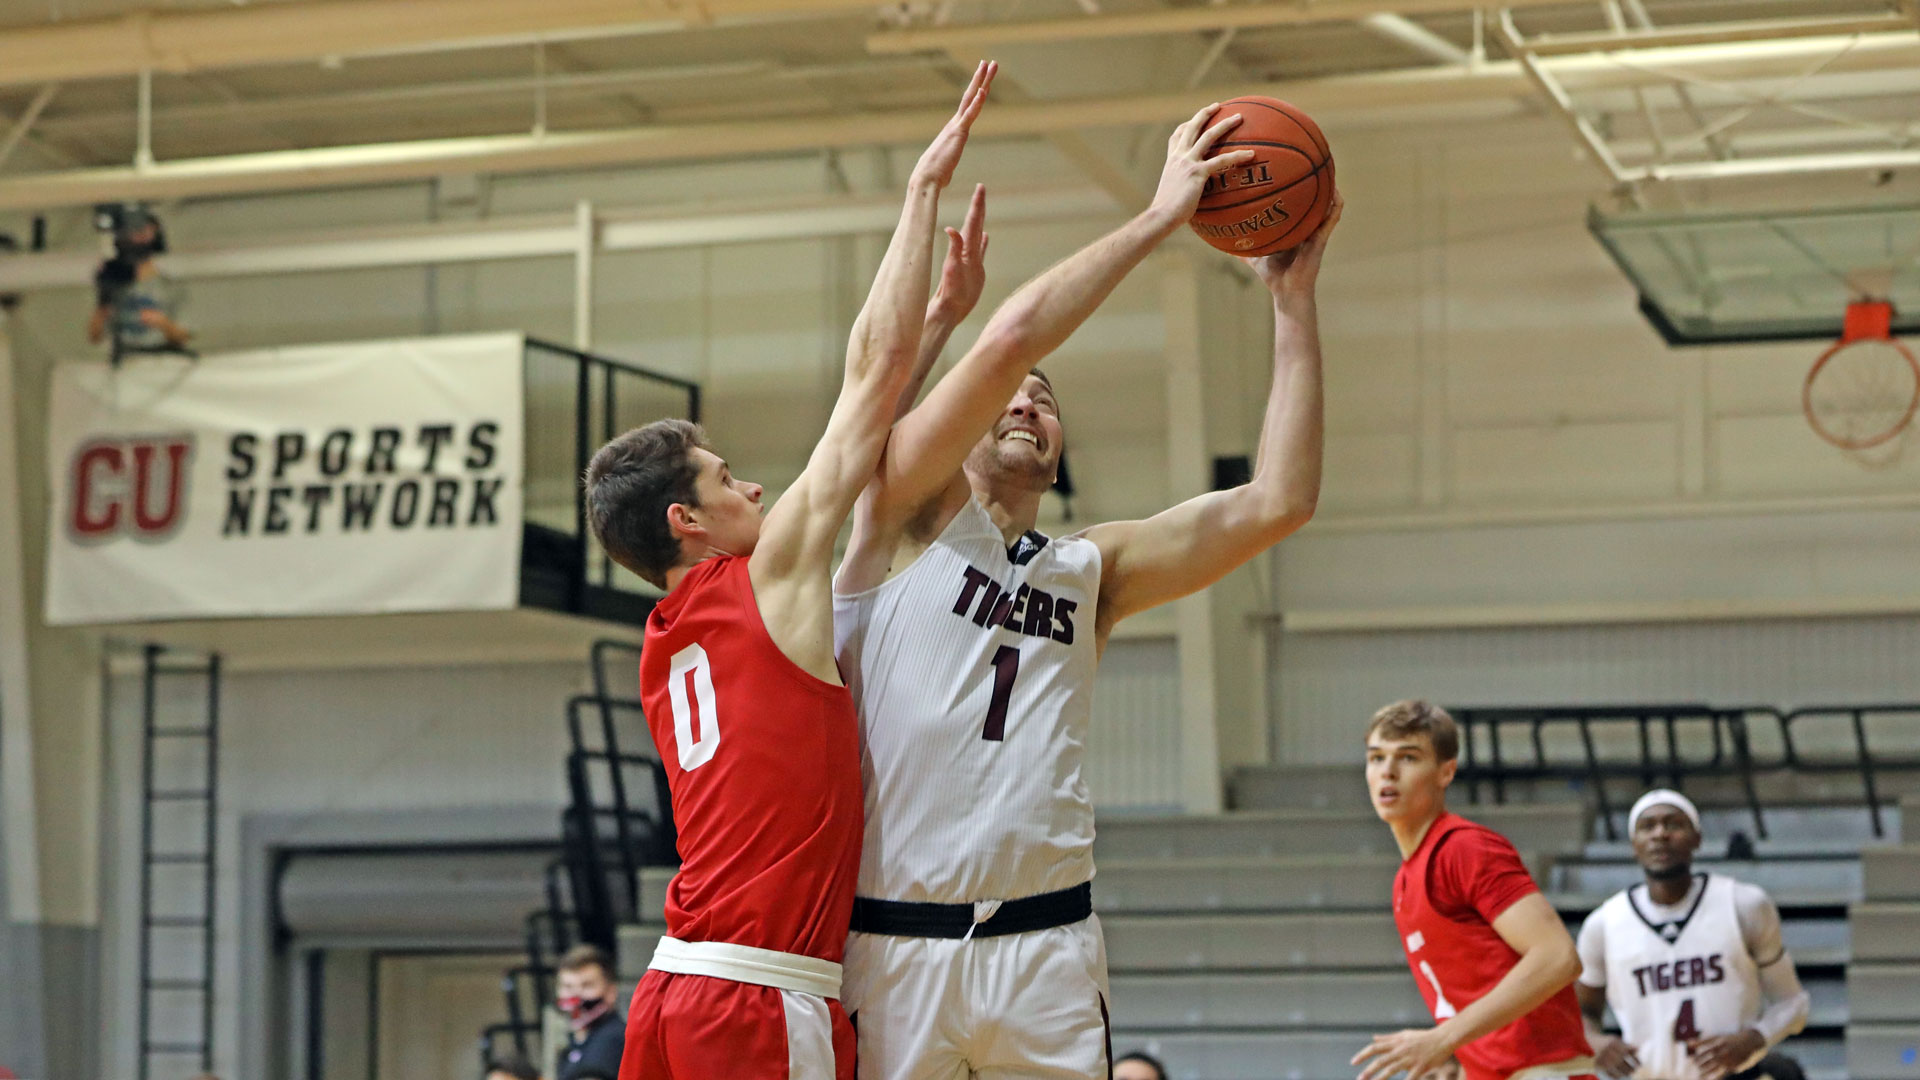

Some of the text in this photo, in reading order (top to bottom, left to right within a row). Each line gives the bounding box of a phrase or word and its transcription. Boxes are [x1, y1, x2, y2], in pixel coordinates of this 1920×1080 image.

[225, 422, 498, 480] SPORTS
[69, 438, 192, 540] CU
[221, 478, 503, 537] NETWORK
[668, 641, 721, 773] 0
[981, 644, 1020, 742] 1
[1632, 952, 1725, 998] TIGERS
[1674, 999, 1702, 1057] 4
